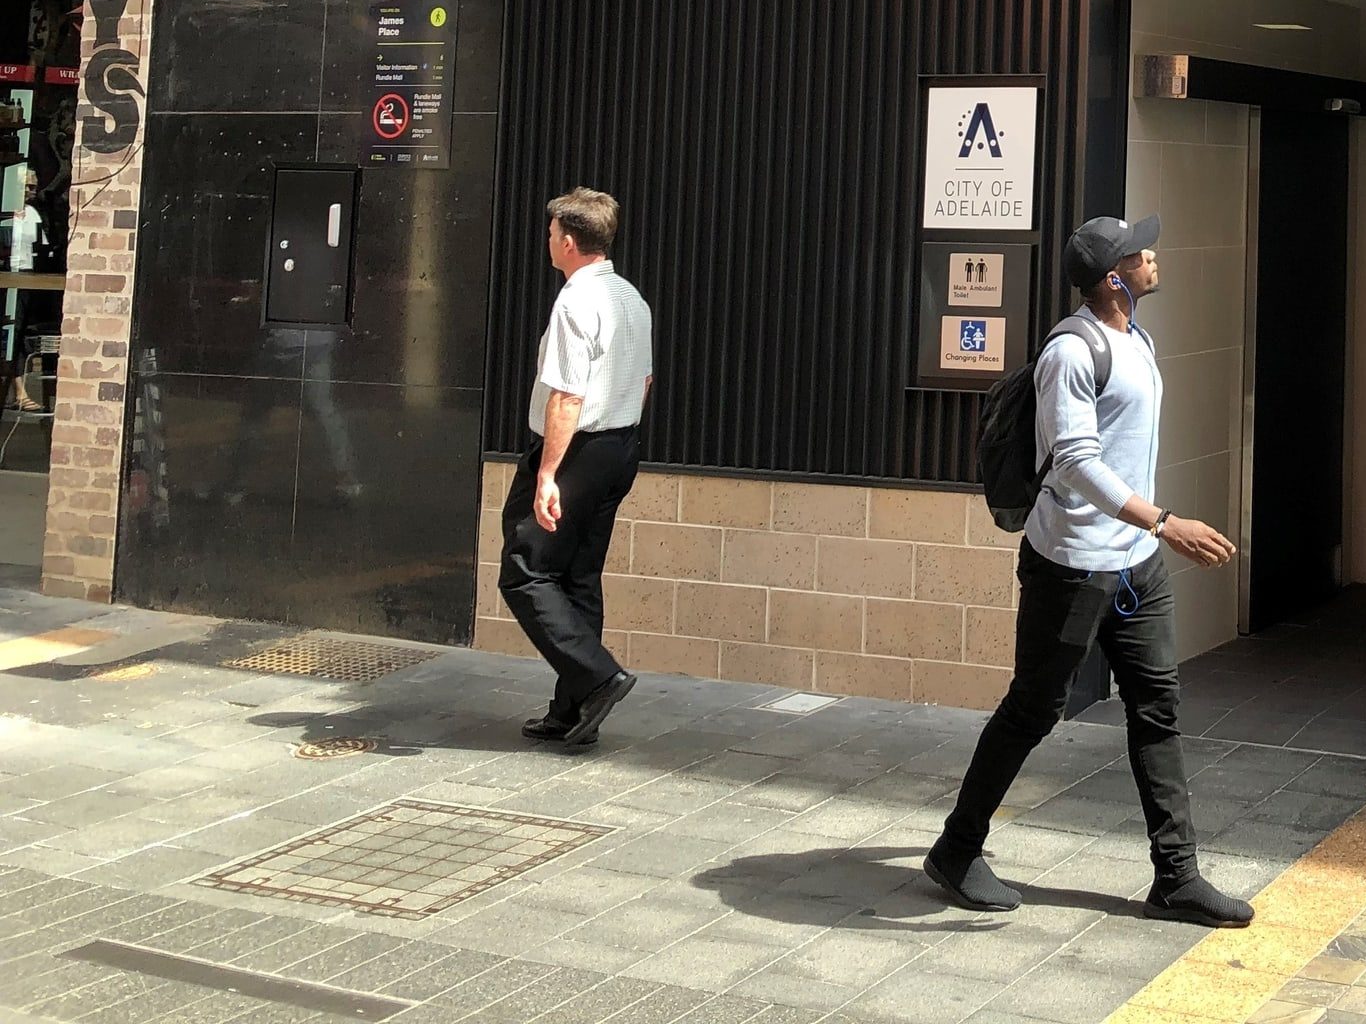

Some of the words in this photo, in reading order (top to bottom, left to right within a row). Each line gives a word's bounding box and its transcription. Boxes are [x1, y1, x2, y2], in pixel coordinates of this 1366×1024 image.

[378, 16, 405, 25] James
[378, 27, 400, 36] Place
[944, 180, 982, 197] CITY
[991, 180, 1014, 197] OF
[934, 200, 1023, 217] ADELAIDE
[953, 284, 967, 292] Male
[945, 353, 977, 363] Changing
[978, 353, 1000, 363] Places
